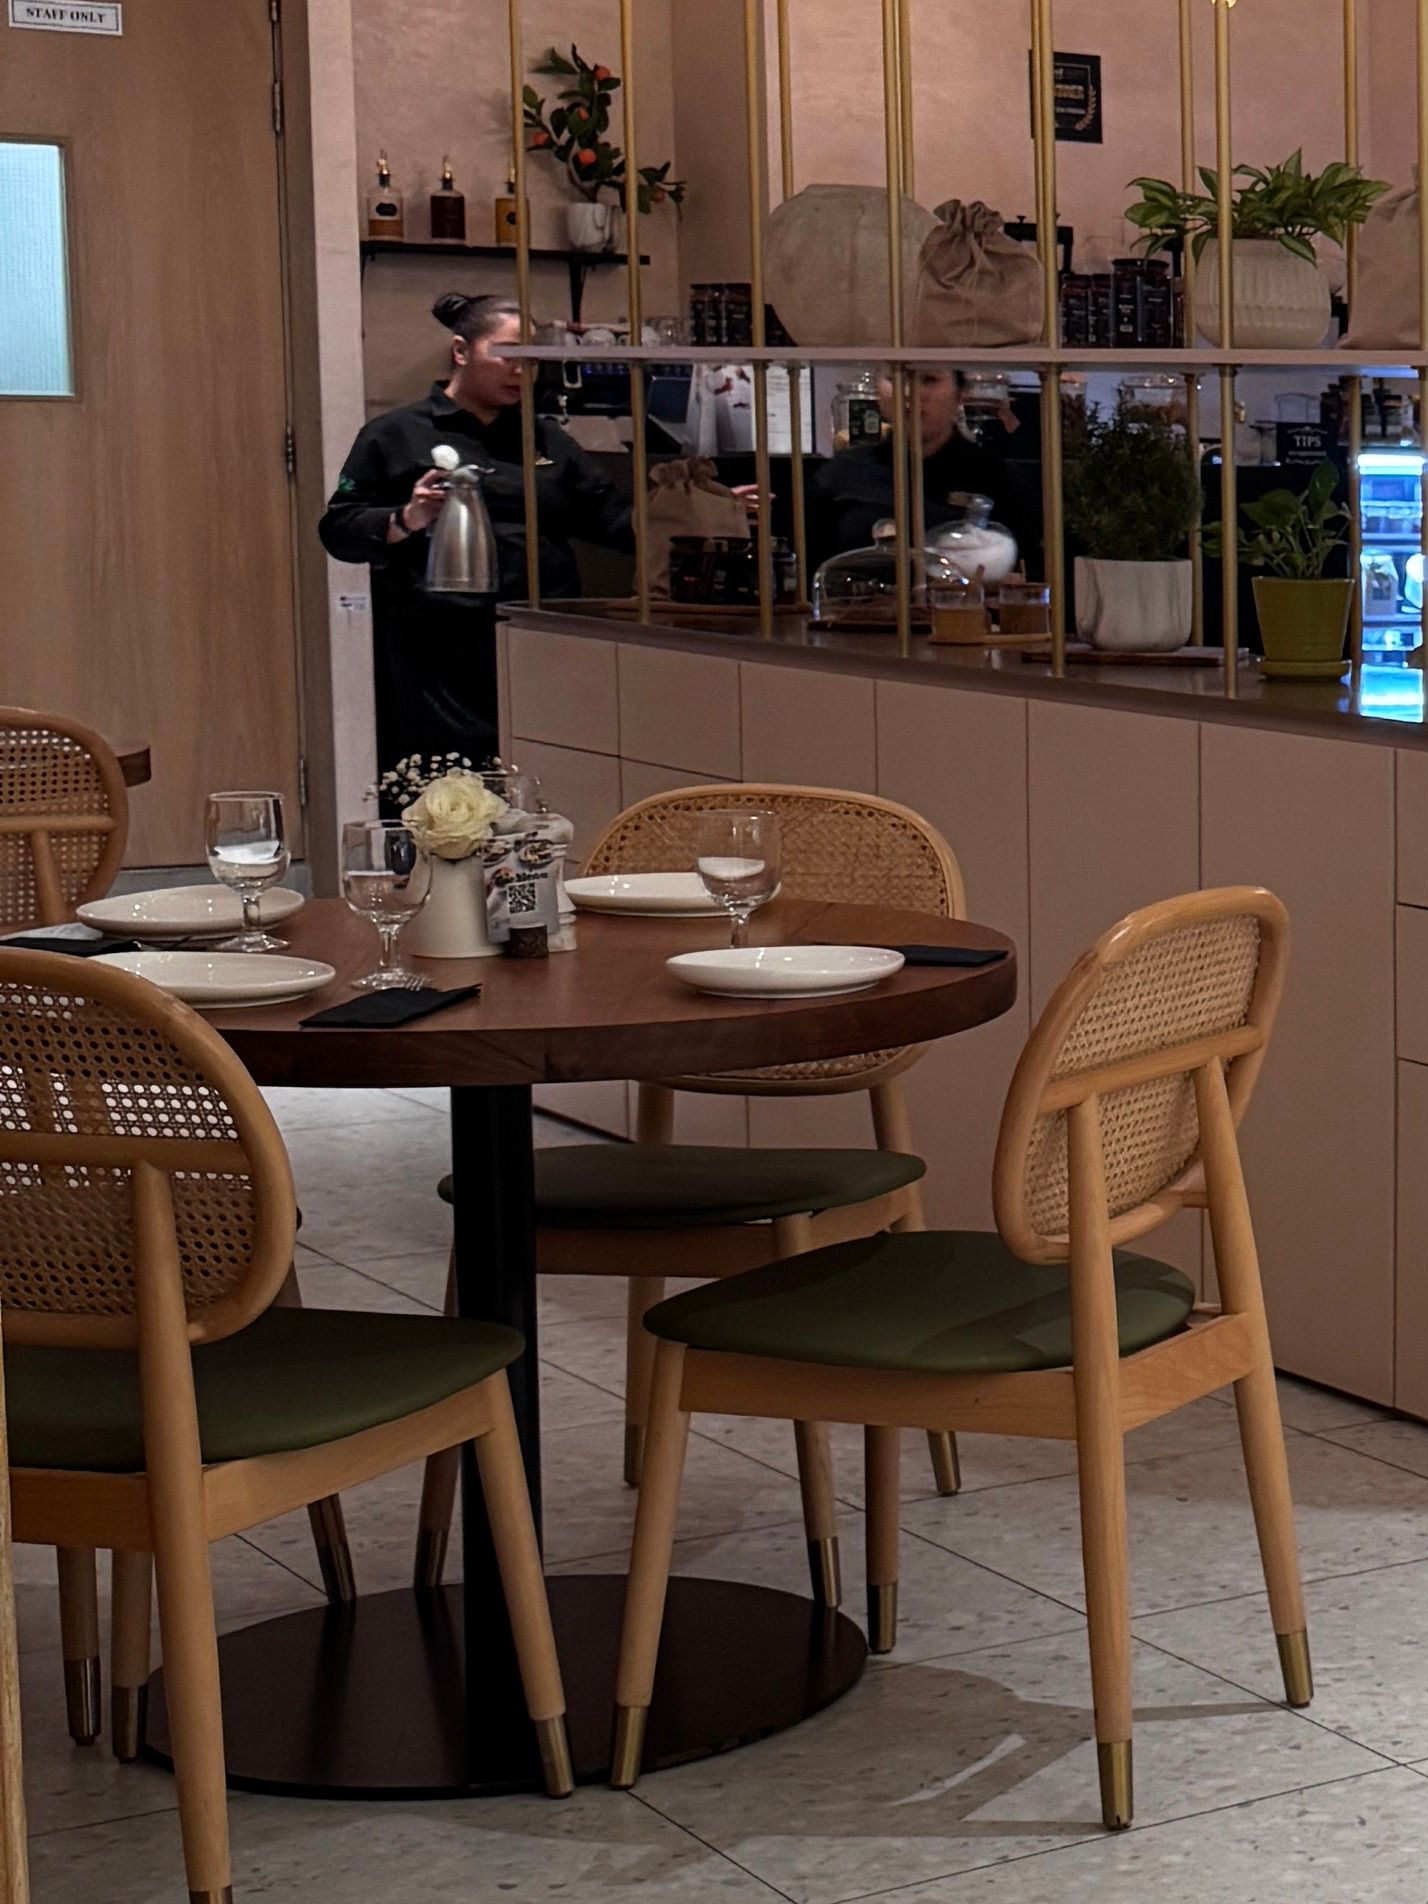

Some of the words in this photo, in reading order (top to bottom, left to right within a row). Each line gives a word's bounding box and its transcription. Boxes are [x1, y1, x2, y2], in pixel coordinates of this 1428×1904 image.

[26, 7, 66, 21] STAFF
[69, 11, 106, 23] ONLY
[1293, 435, 1322, 448] TIPS
